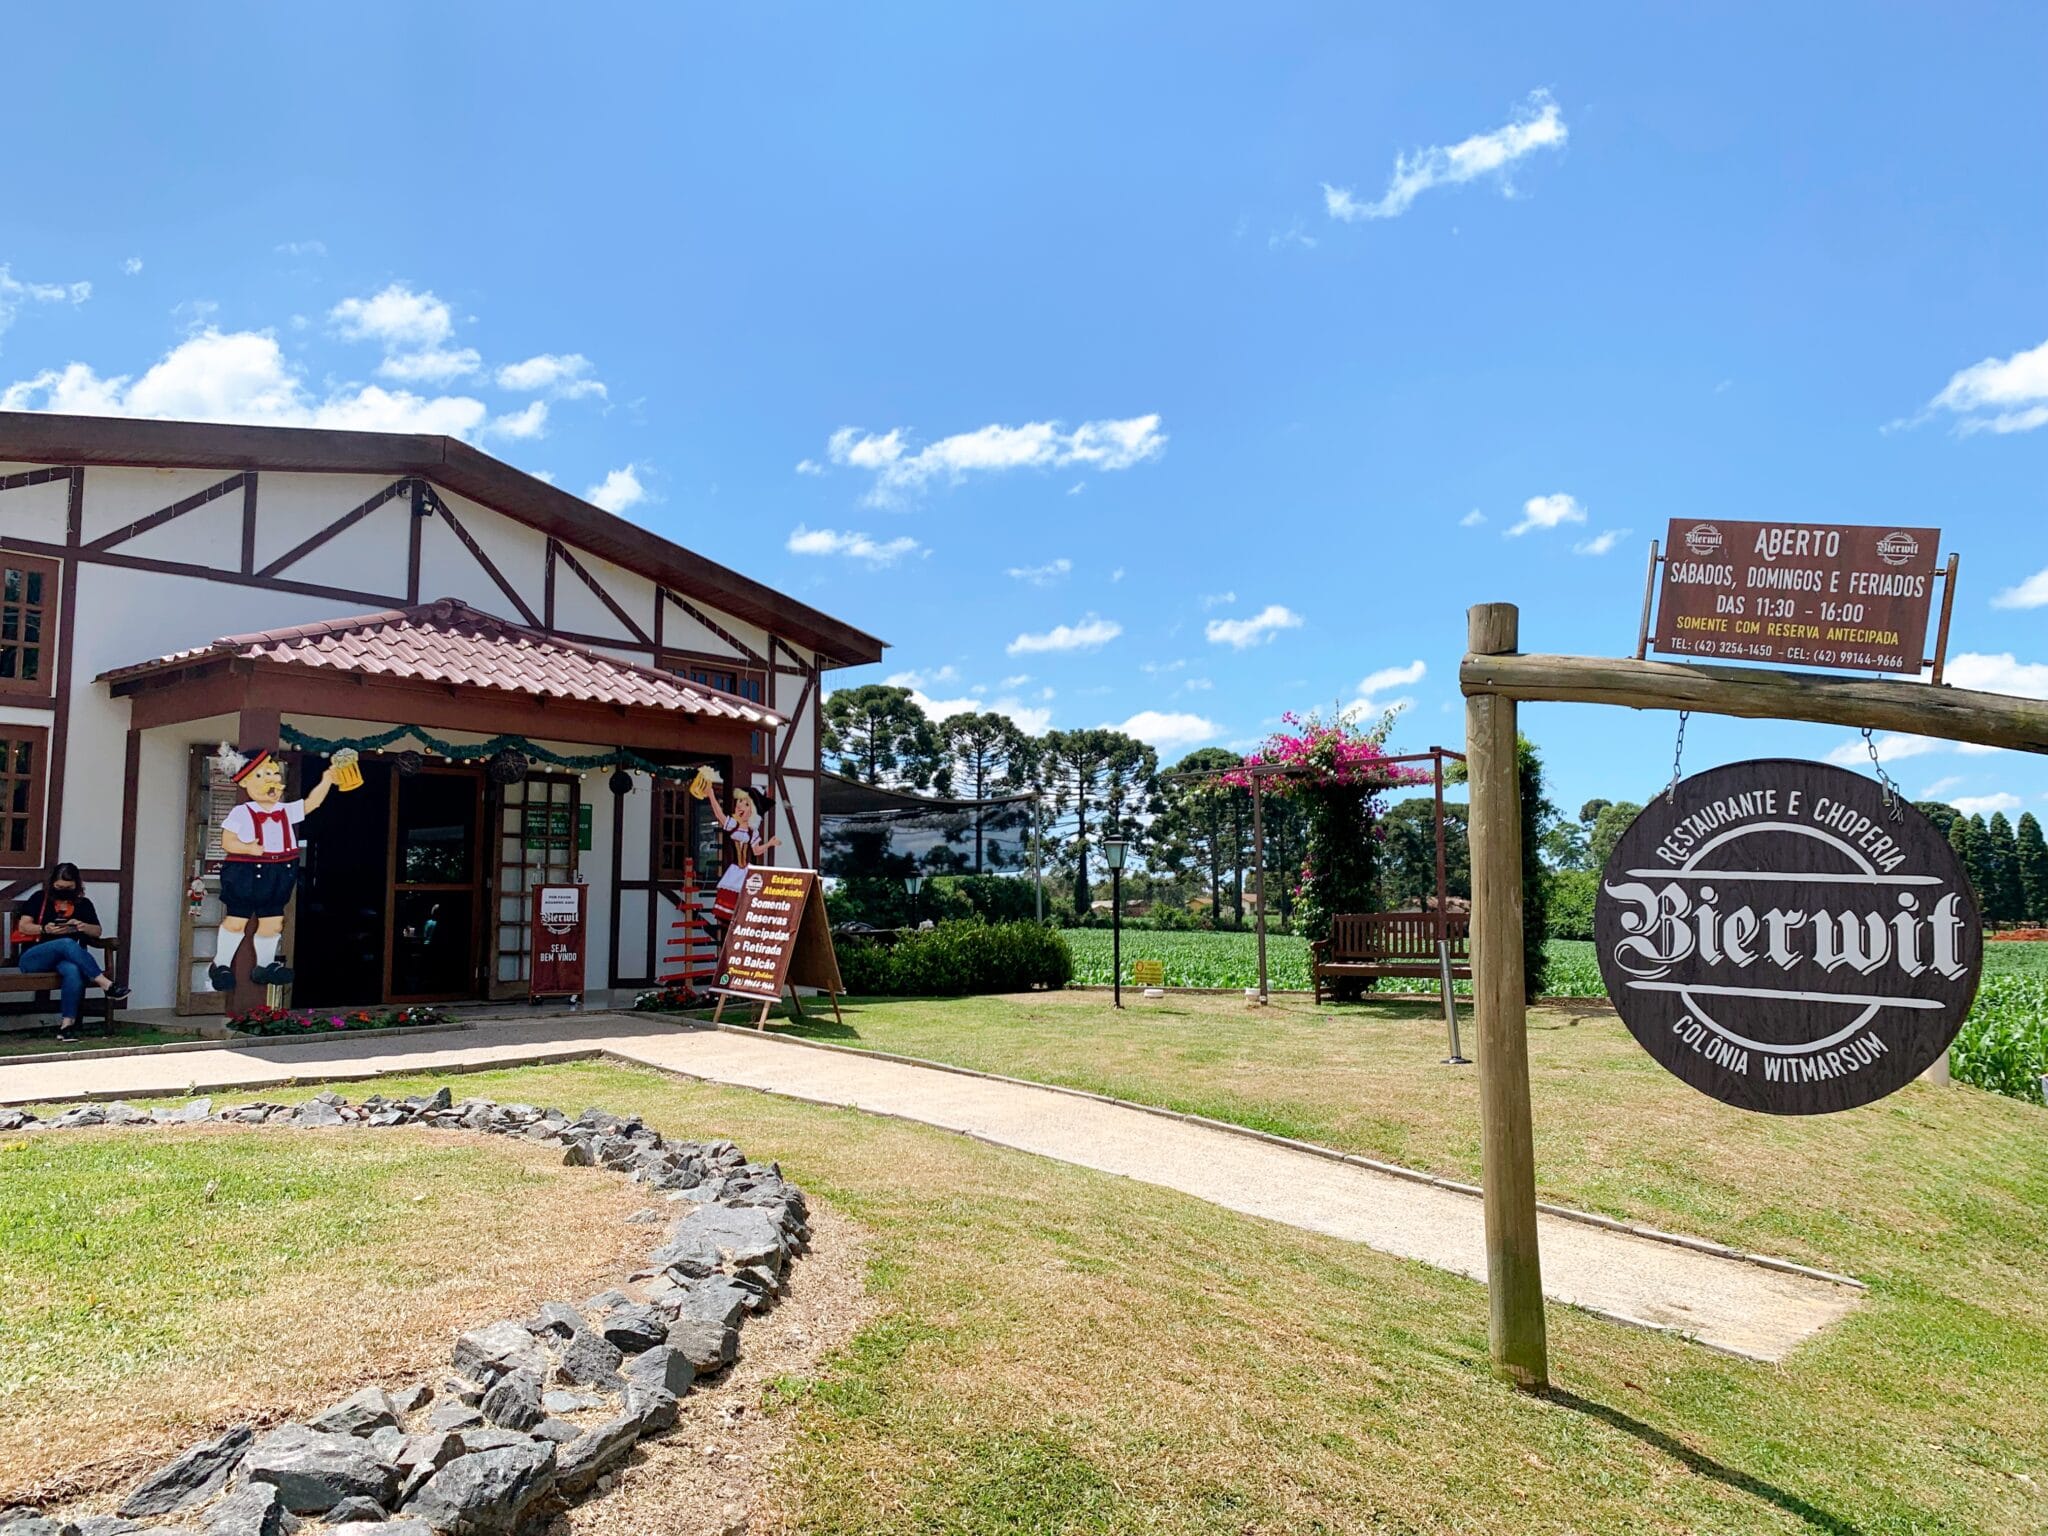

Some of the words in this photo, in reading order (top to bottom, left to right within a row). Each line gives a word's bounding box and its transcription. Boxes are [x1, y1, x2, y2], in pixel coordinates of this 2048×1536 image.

[1754, 528, 1841, 561] ABERTO
[1671, 559, 1737, 590] SÁBADOS,
[1747, 567, 1822, 593] DOMINGOS
[1830, 571, 1840, 593] E
[1850, 572, 1925, 598] FERIADOS
[1716, 595, 1745, 615] DAS
[1756, 597, 1795, 617] 11:30
[1820, 602, 1864, 623] 16:00
[1676, 615, 1727, 632] SOMENTE
[1735, 620, 1760, 634] COM
[1767, 622, 1820, 639] RESERVA
[1827, 628, 1899, 645] ANTECIPADA
[1671, 637, 1692, 650] TEL:
[1695, 639, 1716, 654] (42)
[1719, 641, 1772, 657] 3254-1450
[1787, 647, 1810, 661] CEL:
[1813, 648, 1836, 664] (42)
[1840, 651, 1903, 668] 99144-9666
[1656, 789, 1777, 865] RESTAURANTE
[1788, 791, 1801, 815] E
[1814, 797, 1907, 872] CHOPERIA
[771, 875, 802, 885] Estamos
[751, 897, 791, 911] Somente
[745, 912, 788, 926] Reservas
[1605, 878, 1968, 981] Bierwit
[733, 925, 790, 942] Antecipadas
[540, 953, 554, 962] BEM
[558, 953, 577, 962] VINDO
[551, 944, 567, 953] SEJA
[734, 941, 740, 950] e
[743, 940, 782, 956] Retirada
[728, 957, 741, 966] no
[743, 957, 776, 970] Balcão
[1672, 1014, 1749, 1076] COLÔNIA
[1764, 1031, 1889, 1083] WITMARSUM
